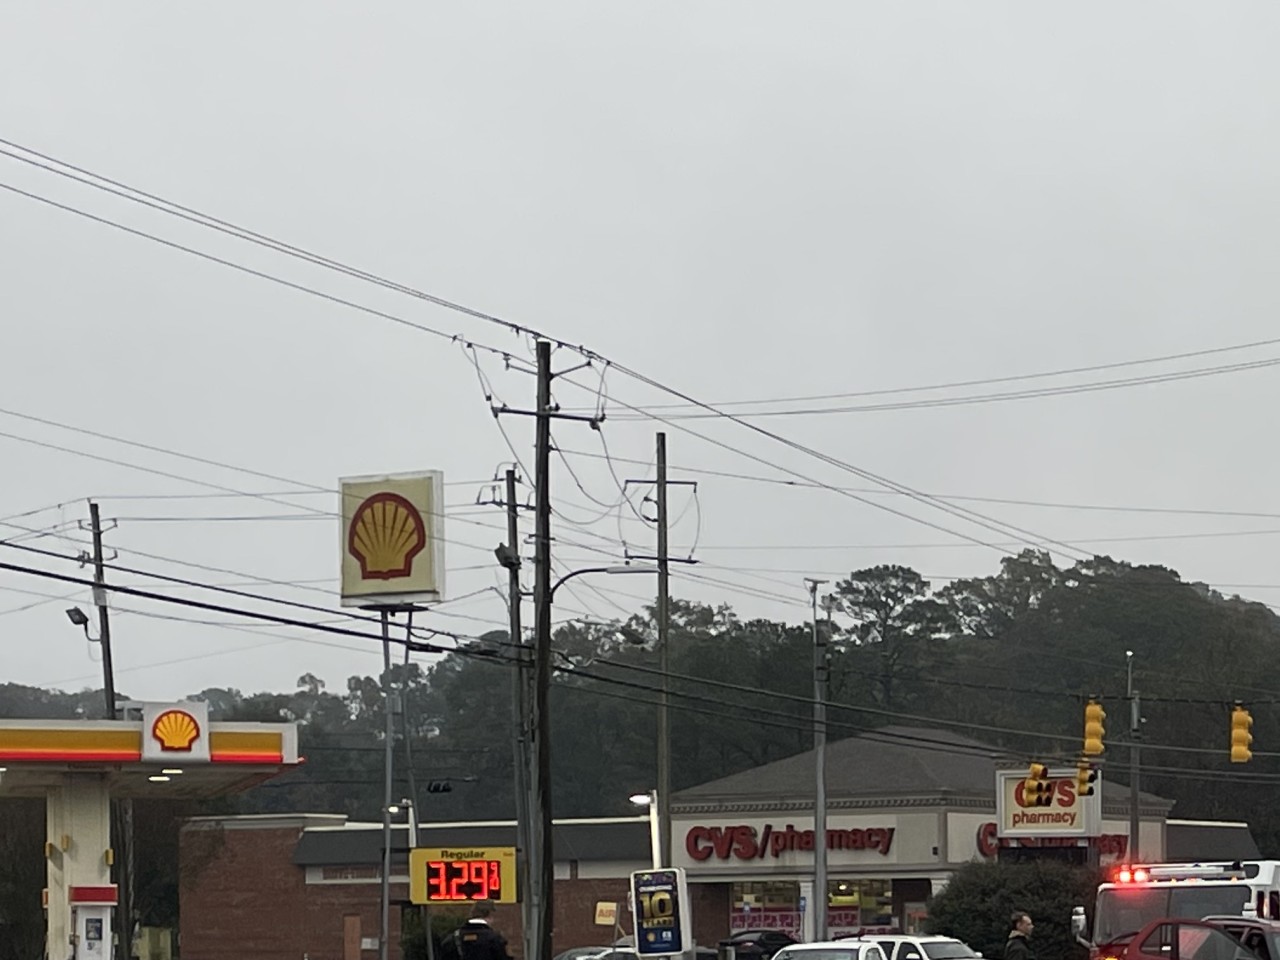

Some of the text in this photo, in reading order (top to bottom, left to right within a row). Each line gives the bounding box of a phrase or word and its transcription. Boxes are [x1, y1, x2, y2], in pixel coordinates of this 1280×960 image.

[1015, 780, 1075, 808] CS
[1013, 811, 1076, 827] pharmacy
[441, 850, 485, 860] Regular
[686, 824, 895, 860] CVS/phamacy
[429, 862, 488, 899] 3.29
[640, 891, 673, 919] 10
